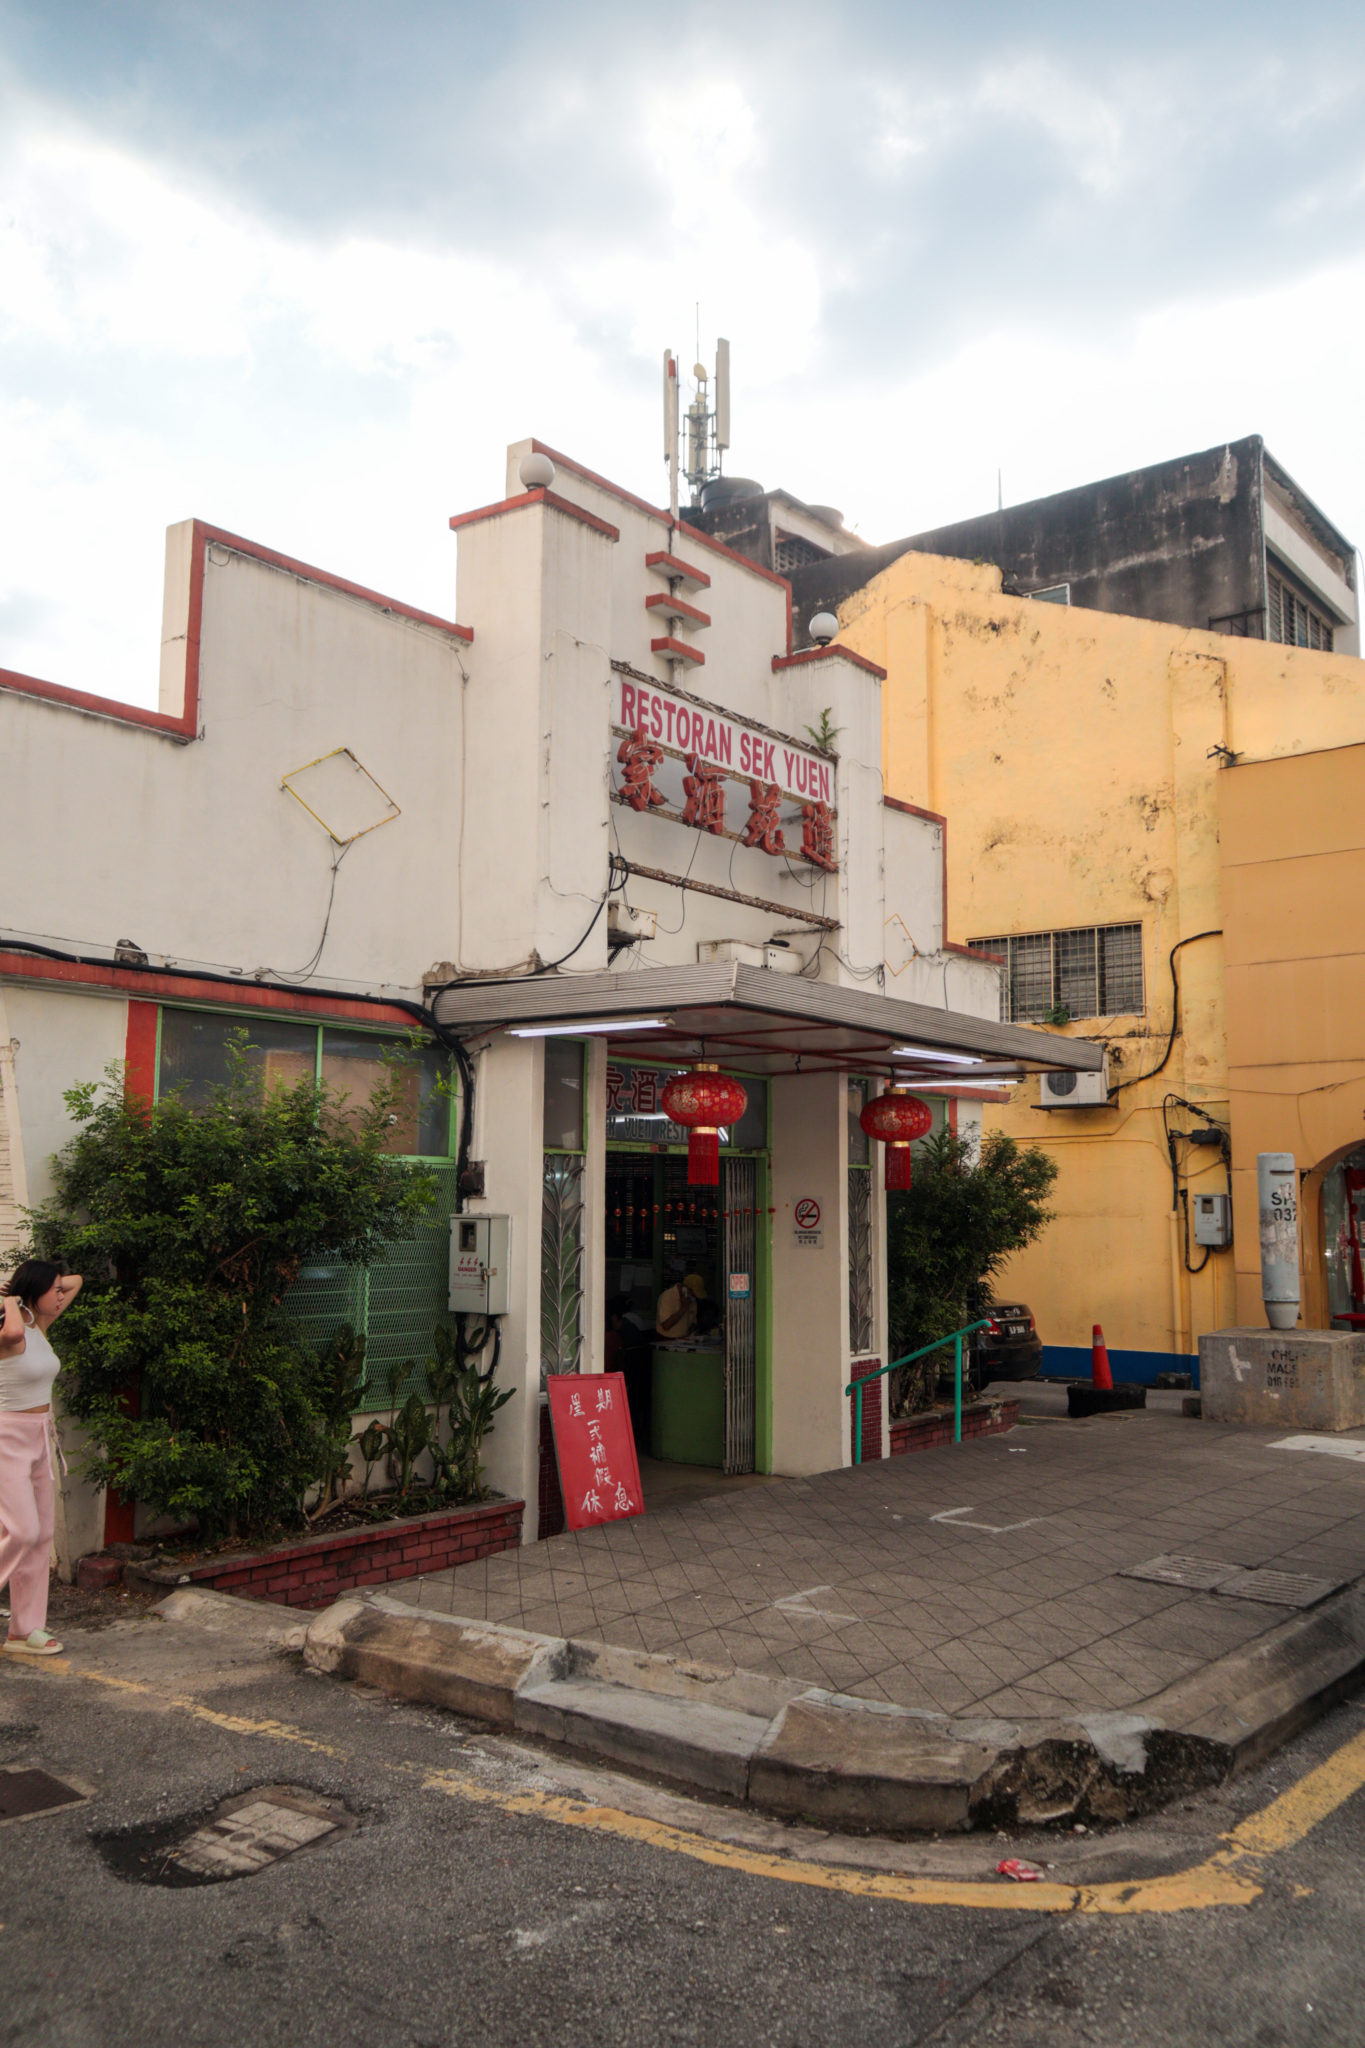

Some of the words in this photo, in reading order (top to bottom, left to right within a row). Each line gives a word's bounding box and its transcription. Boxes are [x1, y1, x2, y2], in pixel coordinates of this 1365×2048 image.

[621, 682, 732, 765] RESTORAN
[740, 732, 776, 782] SEK
[783, 749, 830, 802] YUEN
[730, 1274, 749, 1290] OPEN
[581, 1481, 634, 1513] 休息
